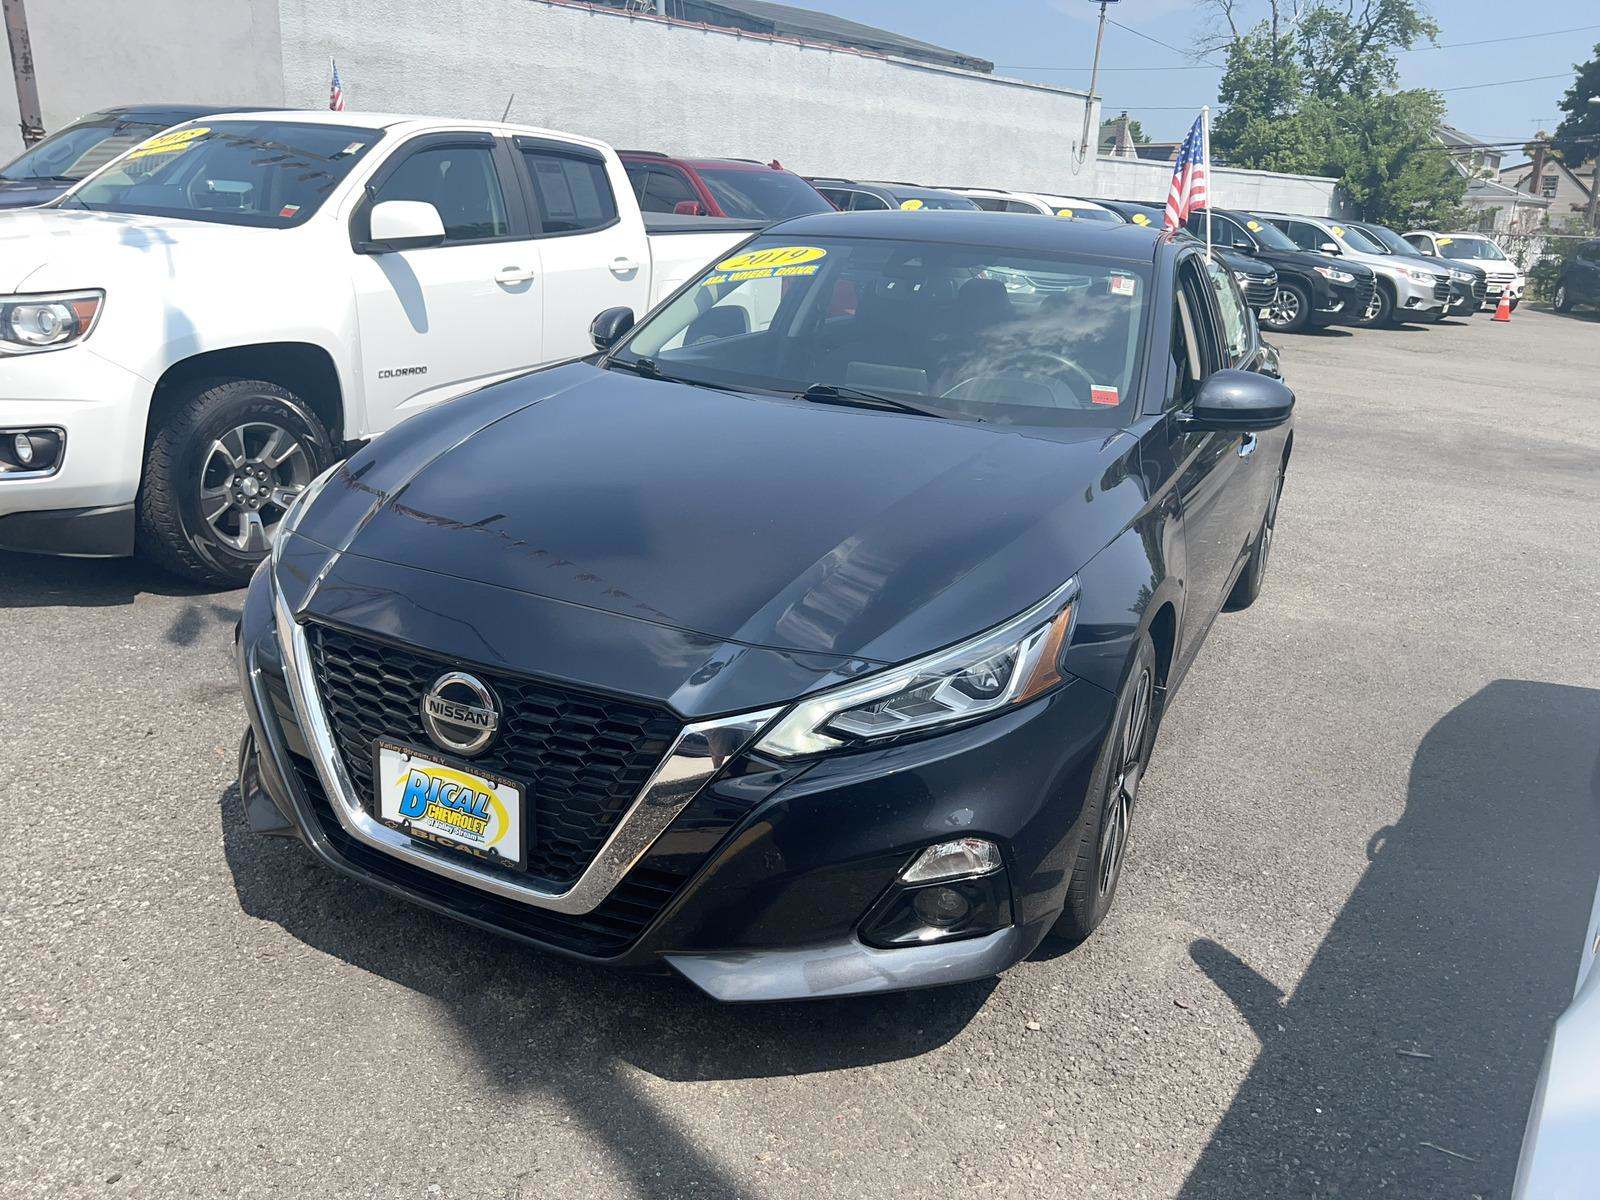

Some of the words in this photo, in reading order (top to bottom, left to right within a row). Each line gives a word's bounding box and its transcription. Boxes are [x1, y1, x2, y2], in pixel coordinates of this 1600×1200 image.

[730, 248, 809, 268] 2019
[728, 269, 773, 281] WHEEL
[773, 265, 820, 277] DRIVE
[378, 366, 428, 379] COLORADO
[429, 699, 489, 727] NISSAN
[399, 768, 491, 820] BICAL
[427, 803, 488, 836] CHEVROLET
[410, 827, 488, 860] BICAL
[454, 828, 478, 841] Stream
